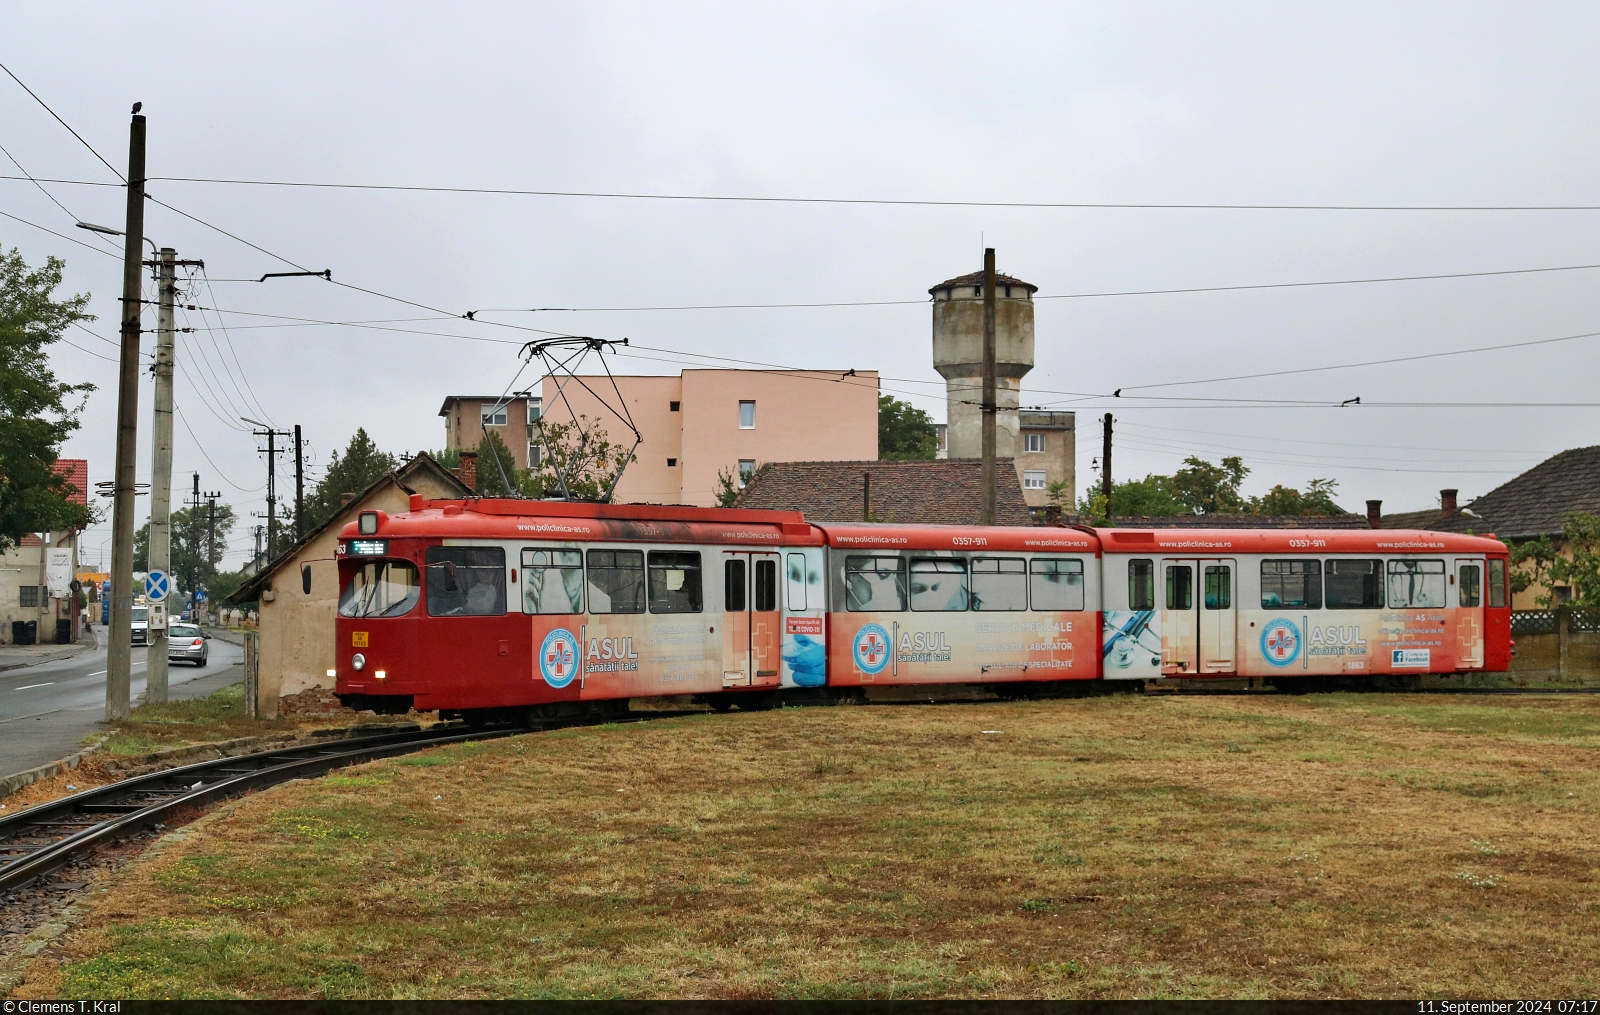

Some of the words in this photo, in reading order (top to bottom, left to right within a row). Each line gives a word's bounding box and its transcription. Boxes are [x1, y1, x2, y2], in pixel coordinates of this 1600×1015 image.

[517, 524, 590, 533] www.policlinica-as.ro
[722, 531, 780, 539] www.policlinica-as.ro
[836, 536, 908, 544] www.policlinica-as.ro
[952, 537, 987, 546] 0357-911
[1025, 539, 1088, 547] www.policlinica-as.ro
[1159, 540, 1232, 548] www.policlinica-as.ro
[1289, 539, 1326, 548] 0357-911
[1022, 621, 1072, 632] MEDICALE
[1309, 625, 1366, 645] ASUL
[898, 632, 951, 652] ASUL
[586, 637, 638, 660] ASUL
[976, 642, 1010, 652] ANALIZE
[1012, 642, 1023, 651] DE
[1026, 642, 1072, 651] LABORATOR
[1347, 645, 1366, 655] tale!
[933, 651, 951, 662] tale!
[621, 660, 638, 671] tale!
[1029, 660, 1072, 668] SPECIALITATE
